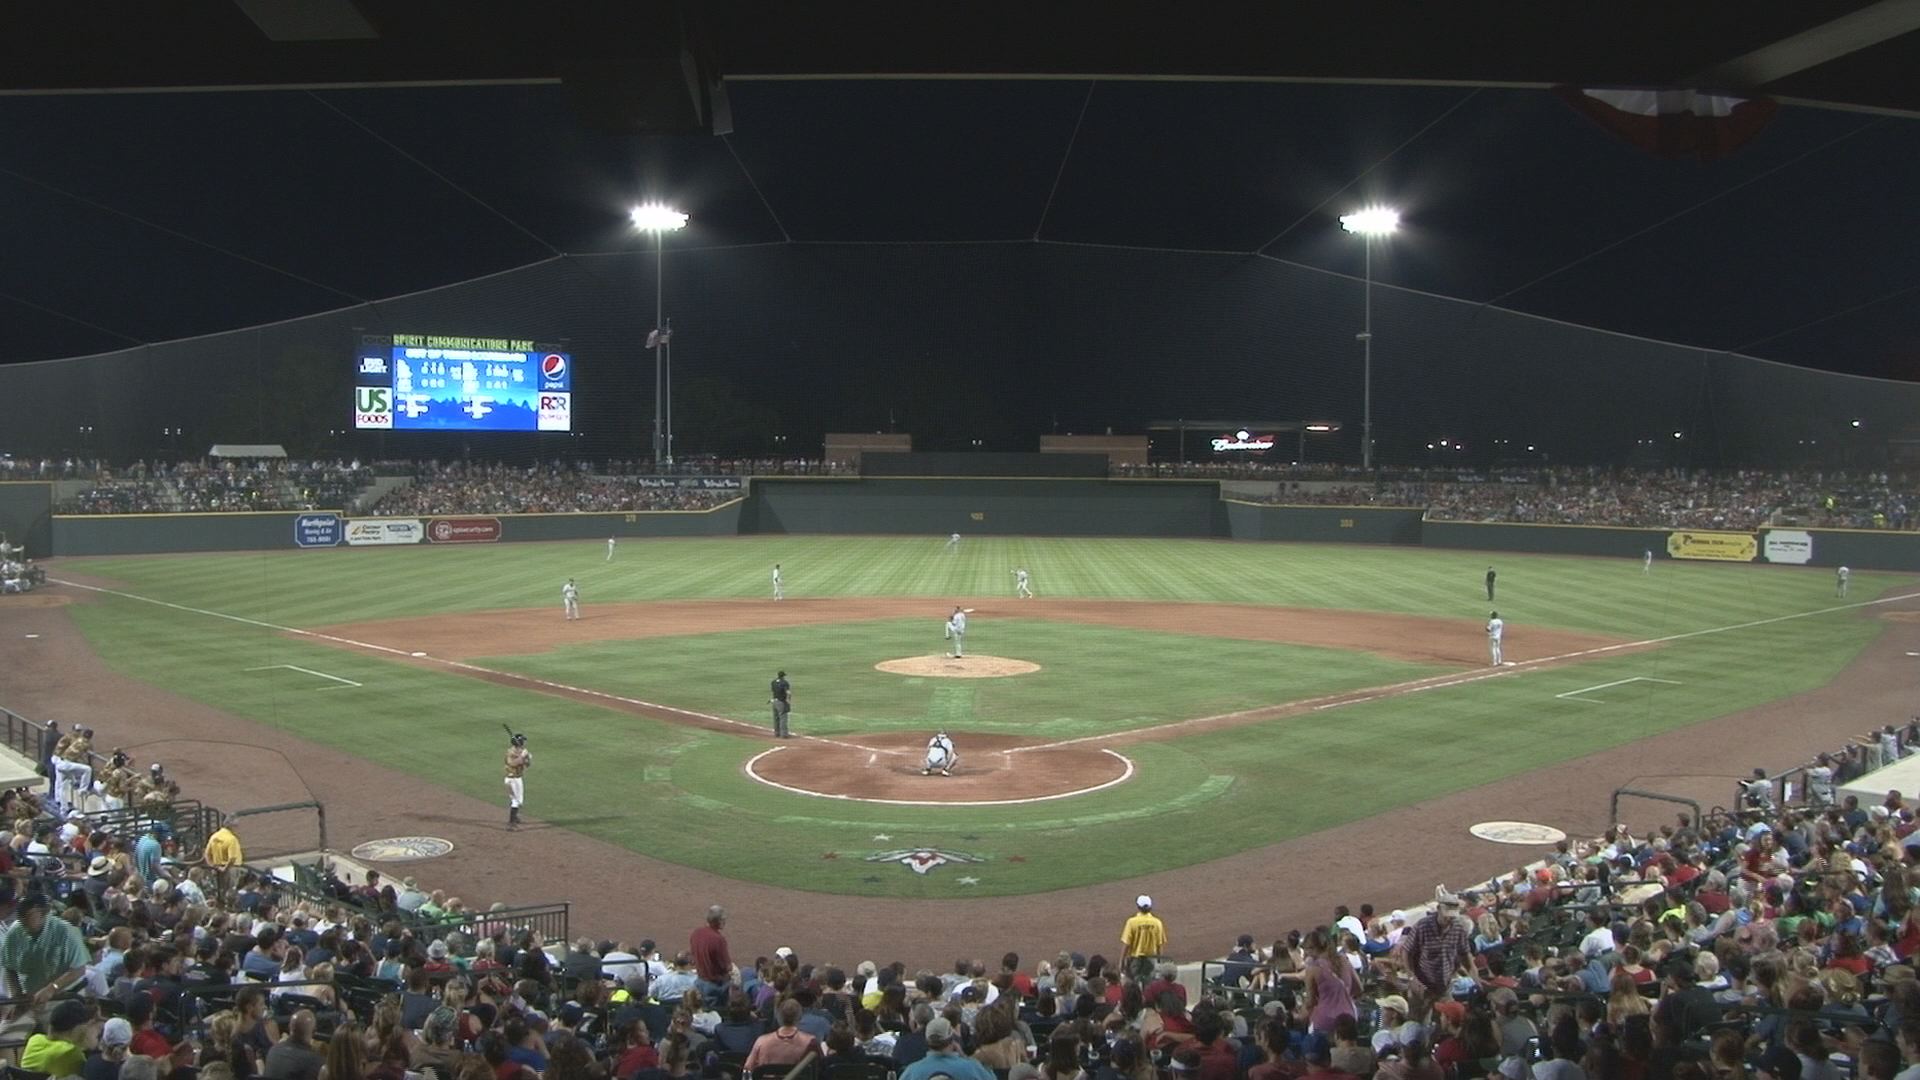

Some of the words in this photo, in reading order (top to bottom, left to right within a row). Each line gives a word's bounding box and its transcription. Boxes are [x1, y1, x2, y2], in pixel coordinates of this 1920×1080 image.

[394, 334, 424, 346] SPIRIT
[427, 335, 508, 350] COMMUNICATIONS
[510, 340, 535, 352] PARK
[357, 414, 389, 424] FOODS
